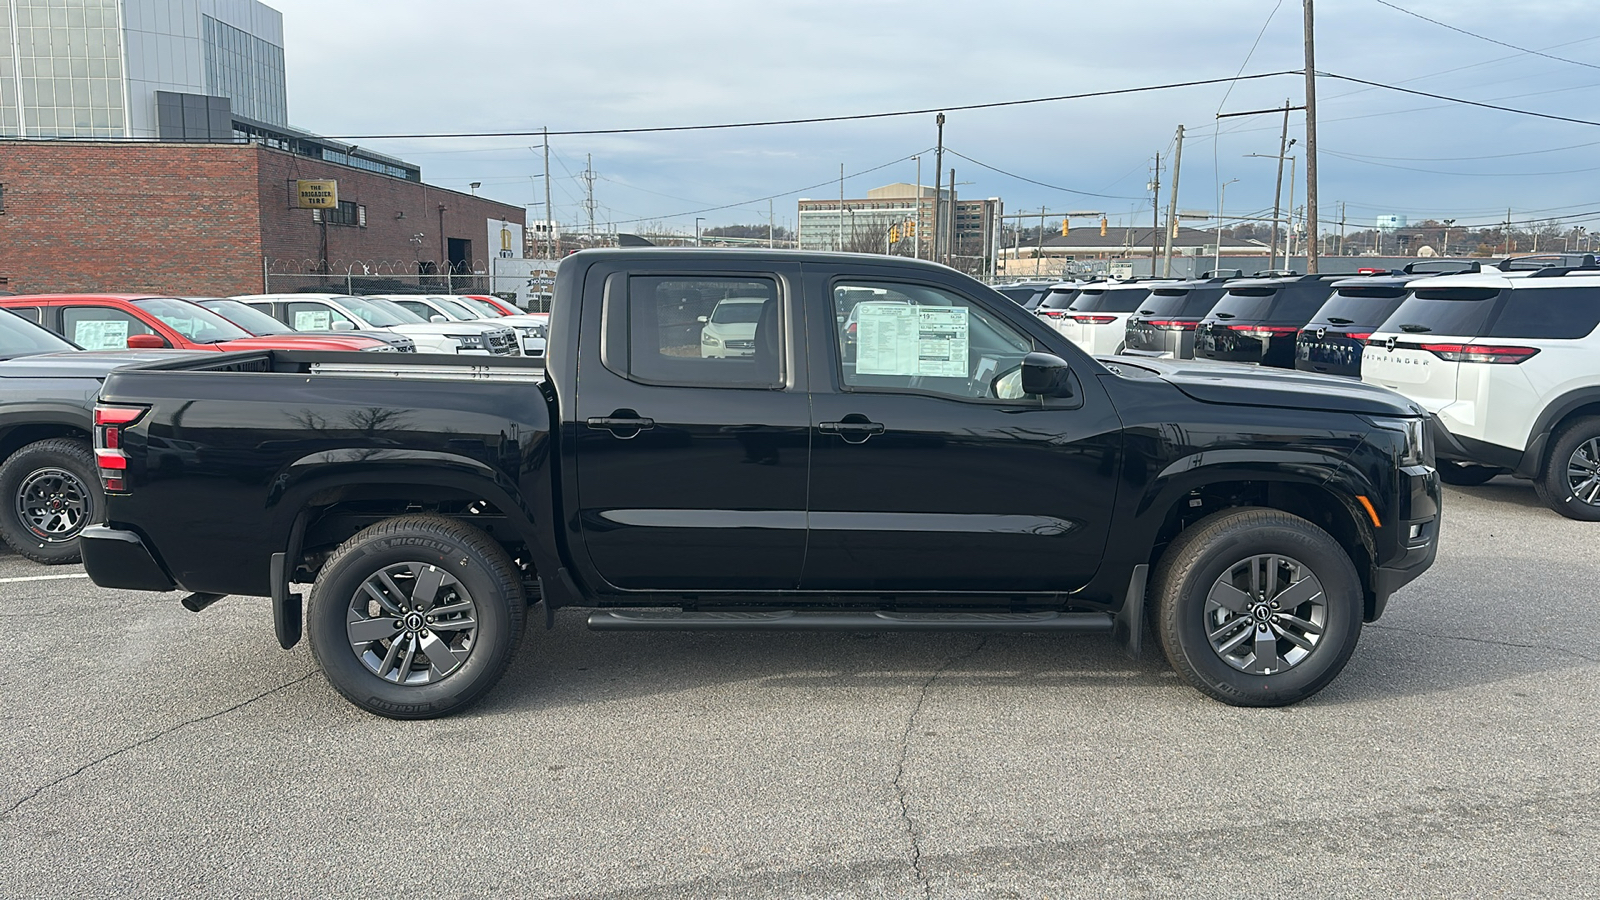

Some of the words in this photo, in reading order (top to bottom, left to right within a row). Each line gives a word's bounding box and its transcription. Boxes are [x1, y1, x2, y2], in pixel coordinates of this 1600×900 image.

[1296, 341, 1354, 352] PATHFINDER
[1363, 353, 1430, 366] PATHFINDER
[390, 537, 452, 553] MICHELIN
[369, 698, 430, 712] MICHELIN
